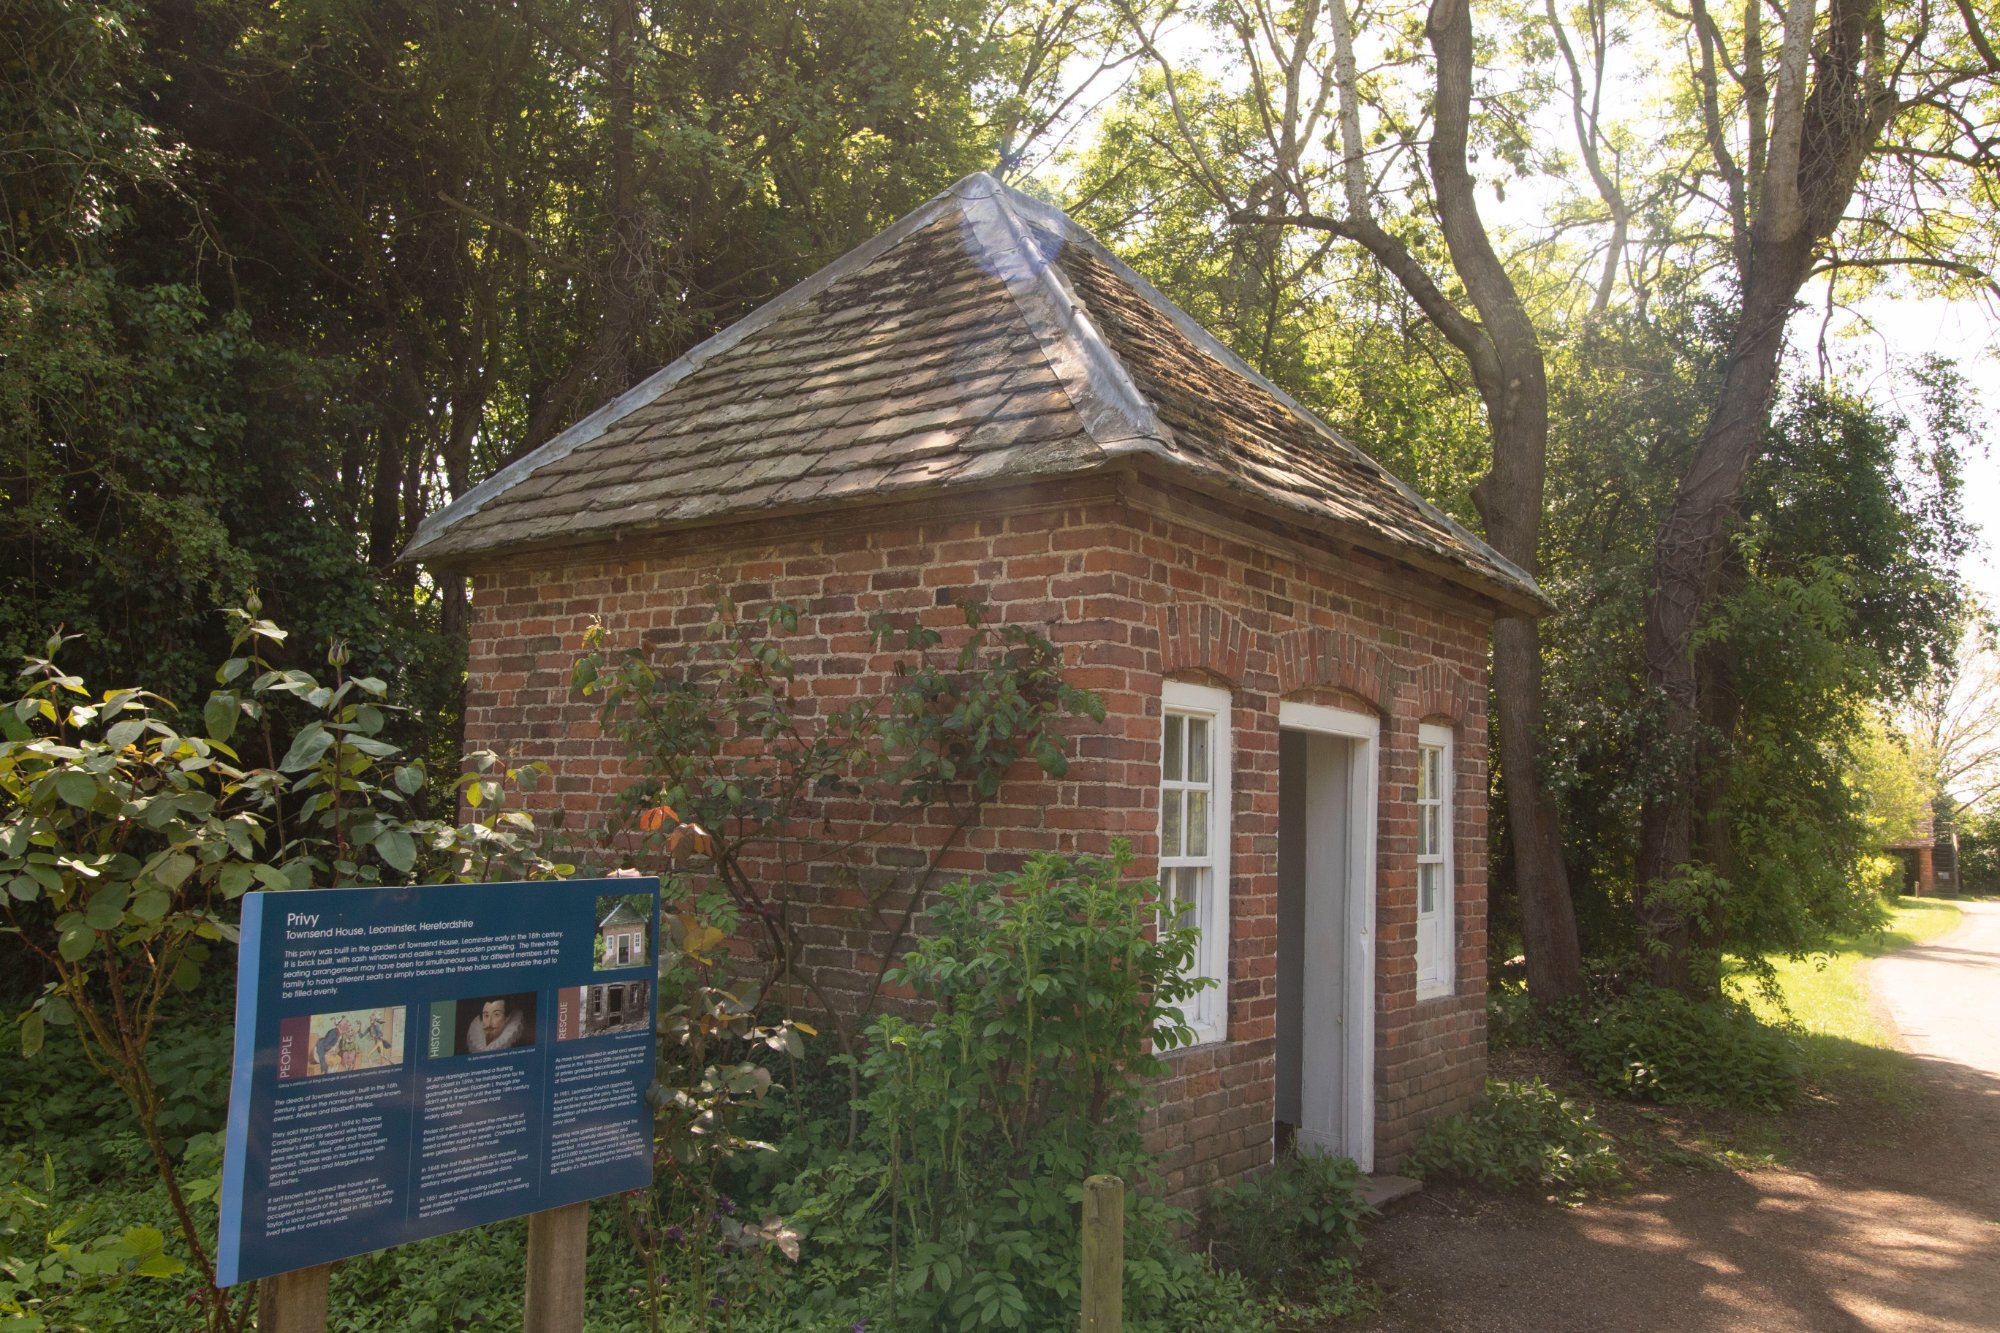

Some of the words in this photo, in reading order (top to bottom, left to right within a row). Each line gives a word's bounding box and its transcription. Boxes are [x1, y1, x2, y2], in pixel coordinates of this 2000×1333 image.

[286, 928, 333, 940] Townsend
[370, 923, 418, 935] Leominster,
[420, 919, 474, 931] Herefordshire
[287, 912, 319, 930] Privy
[300, 950, 317, 958] privy
[372, 944, 397, 953] garden
[462, 936, 493, 944] Leominster
[495, 935, 509, 943] early
[542, 931, 564, 940] century.
[283, 980, 305, 990] family
[336, 975, 364, 983] different
[394, 970, 414, 980] simply
[416, 968, 444, 976] because
[284, 970, 310, 980] seating
[313, 966, 358, 977] arrangement
[426, 957, 465, 966] simultaneous
[314, 987, 338, 997] evenly.
[558, 1001, 568, 1039] RESCUE
[430, 1014, 441, 1057] HISTORY
[280, 1035, 293, 1078] PEOPLE
